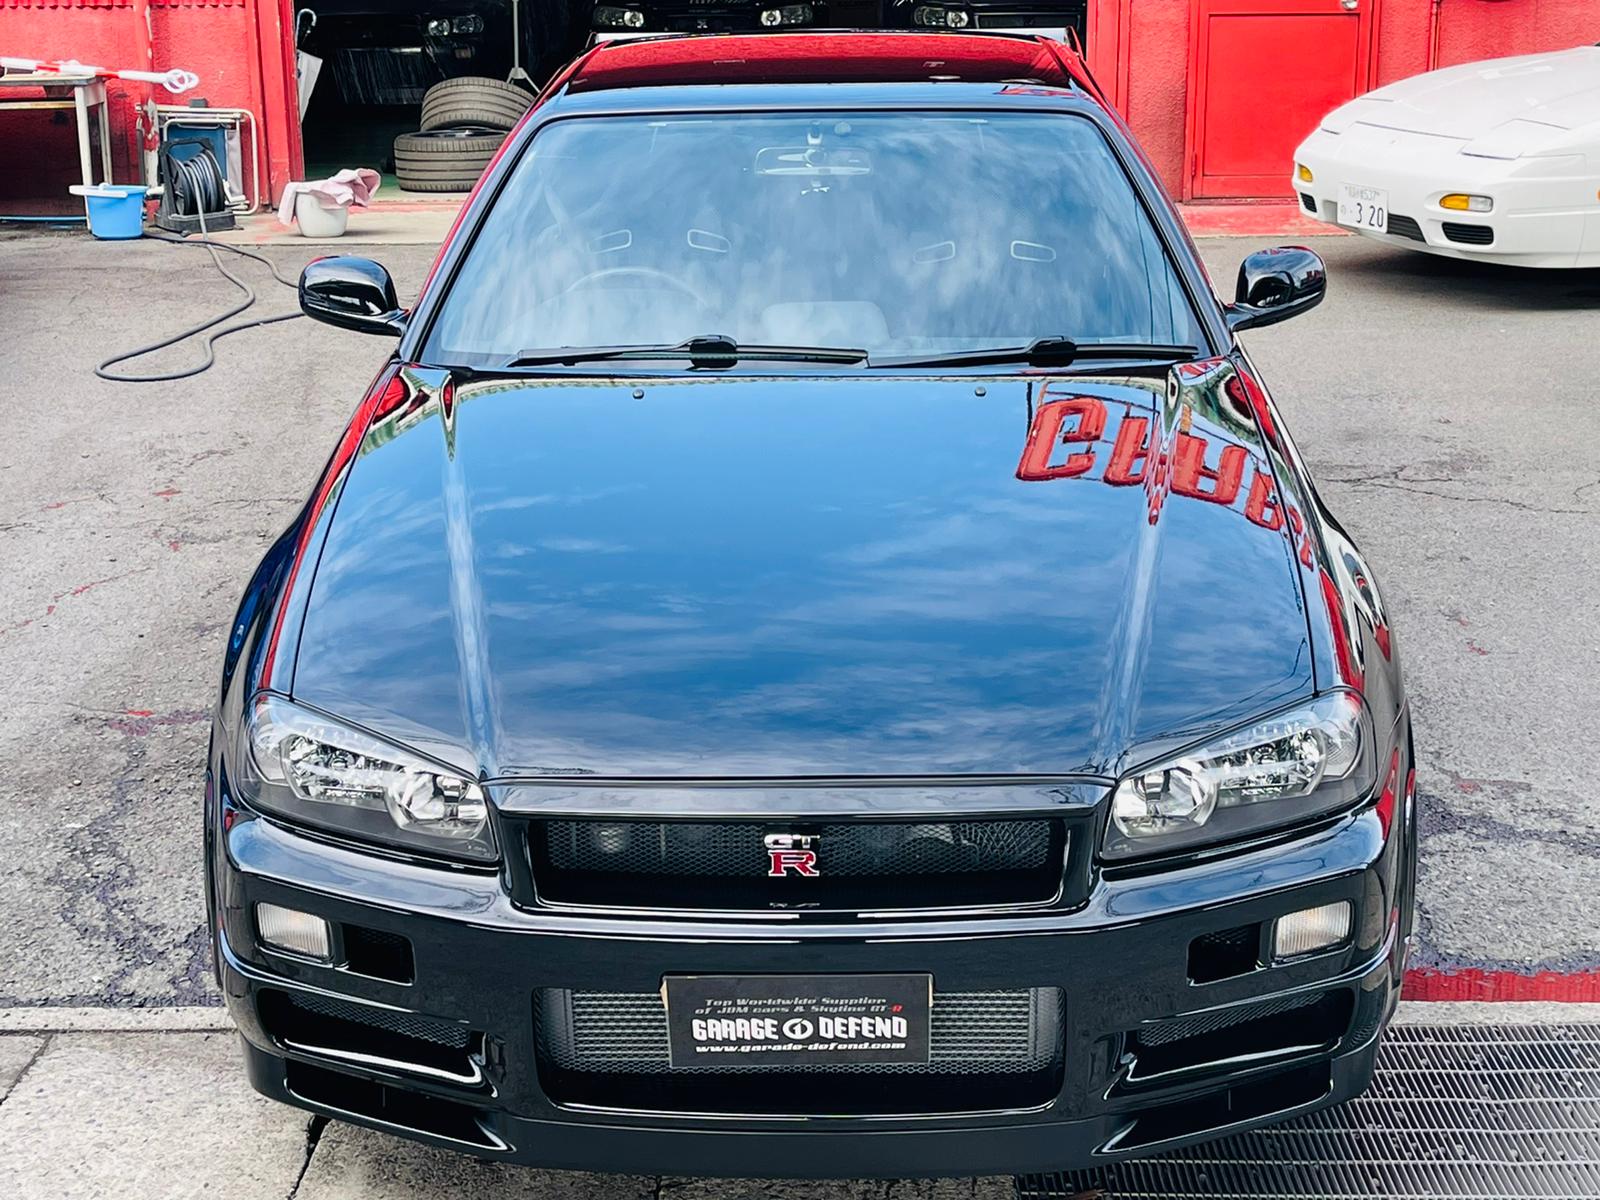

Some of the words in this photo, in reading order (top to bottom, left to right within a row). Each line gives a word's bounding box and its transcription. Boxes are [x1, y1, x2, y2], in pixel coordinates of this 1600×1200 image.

[705, 998, 733, 1007] Top
[736, 997, 817, 1006] Worldwide
[821, 996, 886, 1005] Supplier
[695, 1007, 712, 1015] of
[717, 1006, 749, 1014] JDM
[794, 1005, 805, 1013] &
[811, 1004, 866, 1013] Skyline
[870, 1004, 903, 1013] GT-R
[692, 1018, 779, 1041] GARAGE
[819, 1016, 908, 1039] DEFEND
